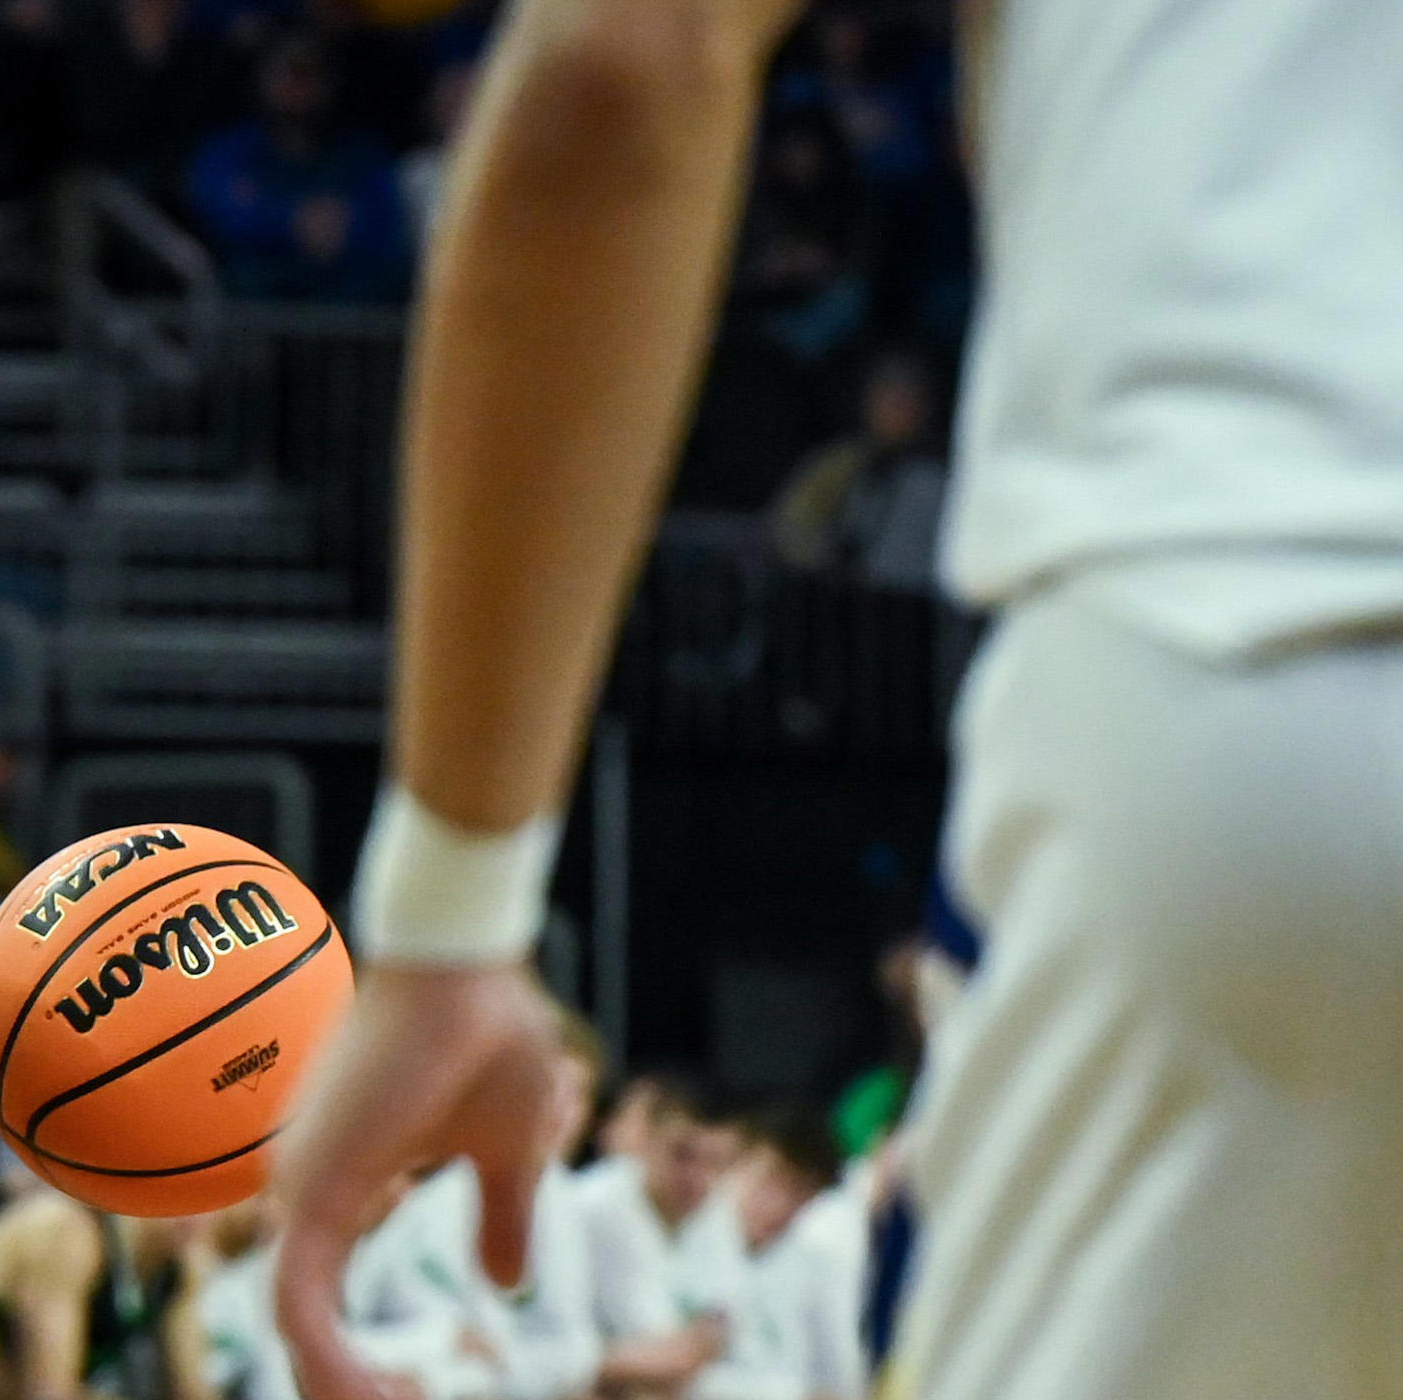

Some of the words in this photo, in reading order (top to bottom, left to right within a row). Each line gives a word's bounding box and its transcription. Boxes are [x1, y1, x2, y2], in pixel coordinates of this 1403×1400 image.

[17, 829, 186, 940] NCAA
[54, 881, 298, 1033] Wilson
[210, 1037, 280, 1093] SUMMIT
